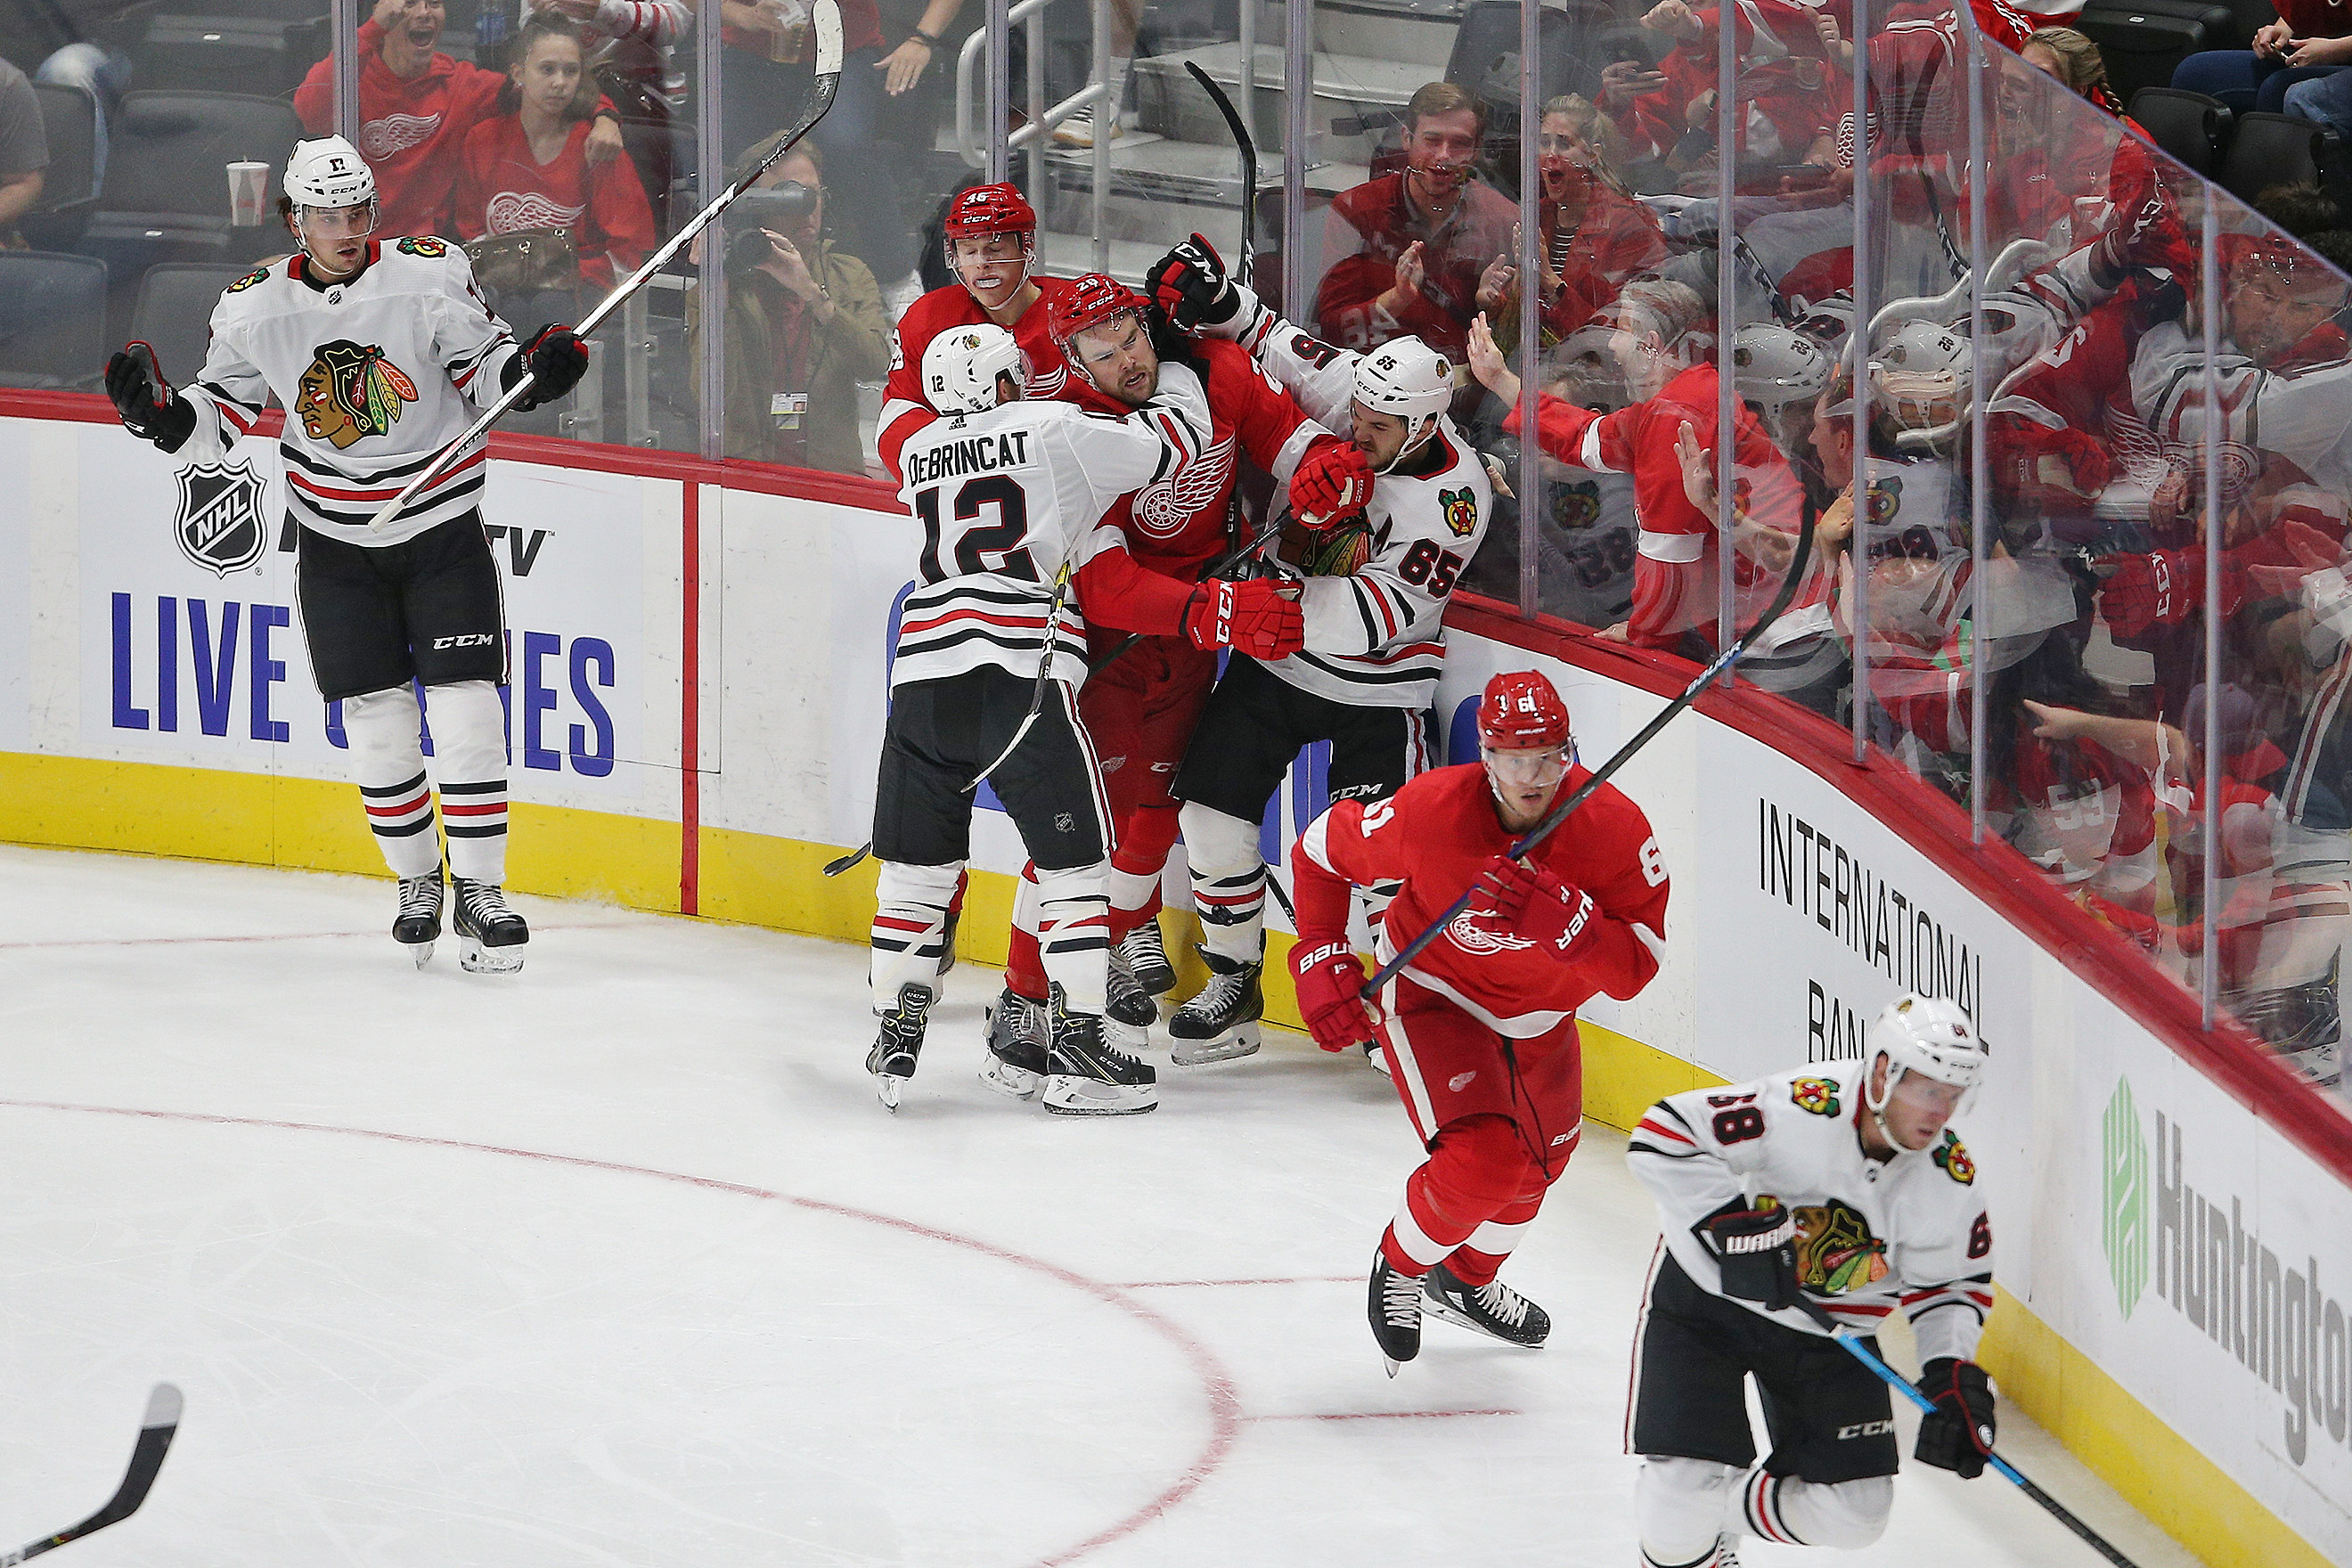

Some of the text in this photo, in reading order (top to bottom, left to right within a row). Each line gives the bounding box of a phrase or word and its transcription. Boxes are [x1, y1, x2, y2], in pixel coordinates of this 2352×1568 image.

[329, 158, 346, 172] 17
[331, 185, 358, 194] CCM
[962, 215, 992, 225] CCM
[1087, 294, 1115, 311] CCM
[1376, 355, 1398, 372] 65
[931, 375, 945, 393] 12
[1357, 380, 1380, 396] CCM
[195, 488, 248, 548] NHL
[1227, 501, 1236, 534] CCM
[916, 474, 1041, 590] 12
[1398, 537, 1465, 600] 65
[1215, 580, 1235, 645] CCM
[432, 632, 494, 650] CCM
[111, 592, 290, 743] LIVE
[1330, 783, 1384, 804] CCM
[1637, 835, 1669, 888] 6
[1555, 888, 1595, 951] UER
[1760, 797, 1989, 1057] INTERNATIONAL
[1098, 1055, 1123, 1073] CCM
[2155, 1108, 2352, 1467] Huntingto
